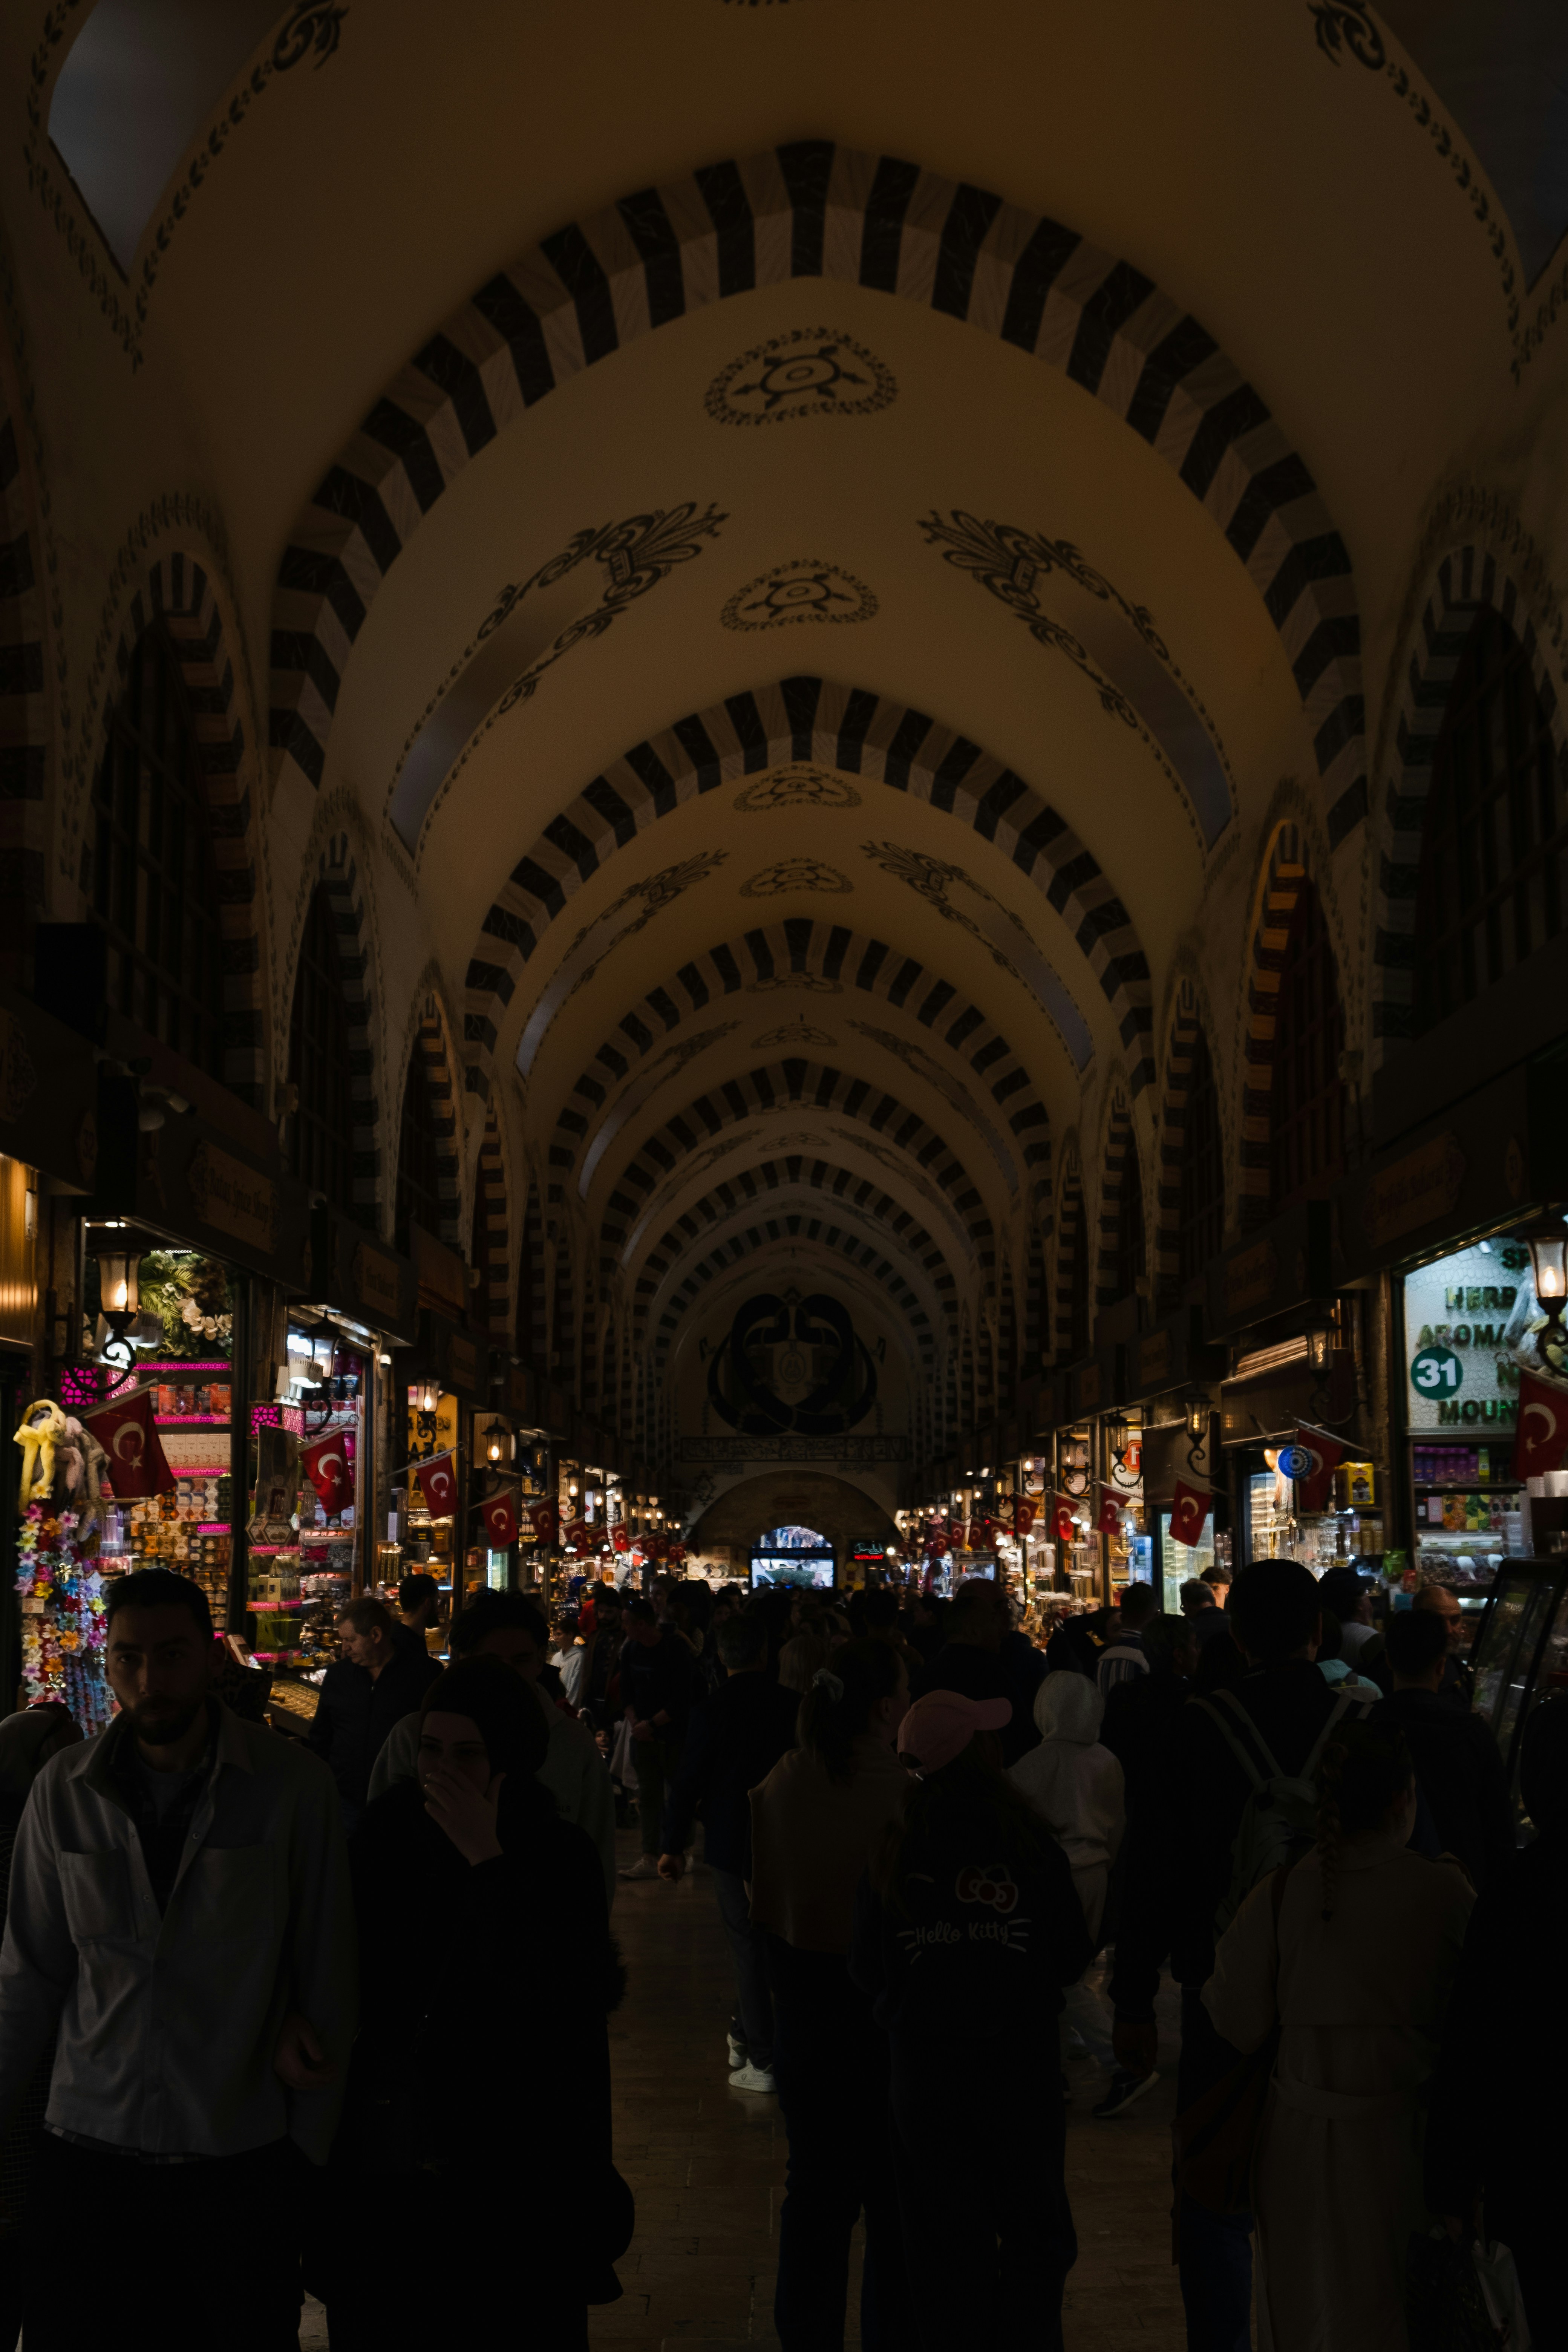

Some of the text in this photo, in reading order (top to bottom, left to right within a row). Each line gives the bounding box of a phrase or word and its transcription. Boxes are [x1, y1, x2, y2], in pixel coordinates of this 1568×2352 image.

[232, 1180, 251, 1218] Spice
[253, 1191, 269, 1232] Shop
[1416, 1358, 1456, 1388] 31
[916, 1920, 1009, 1945] Hello Kitty
